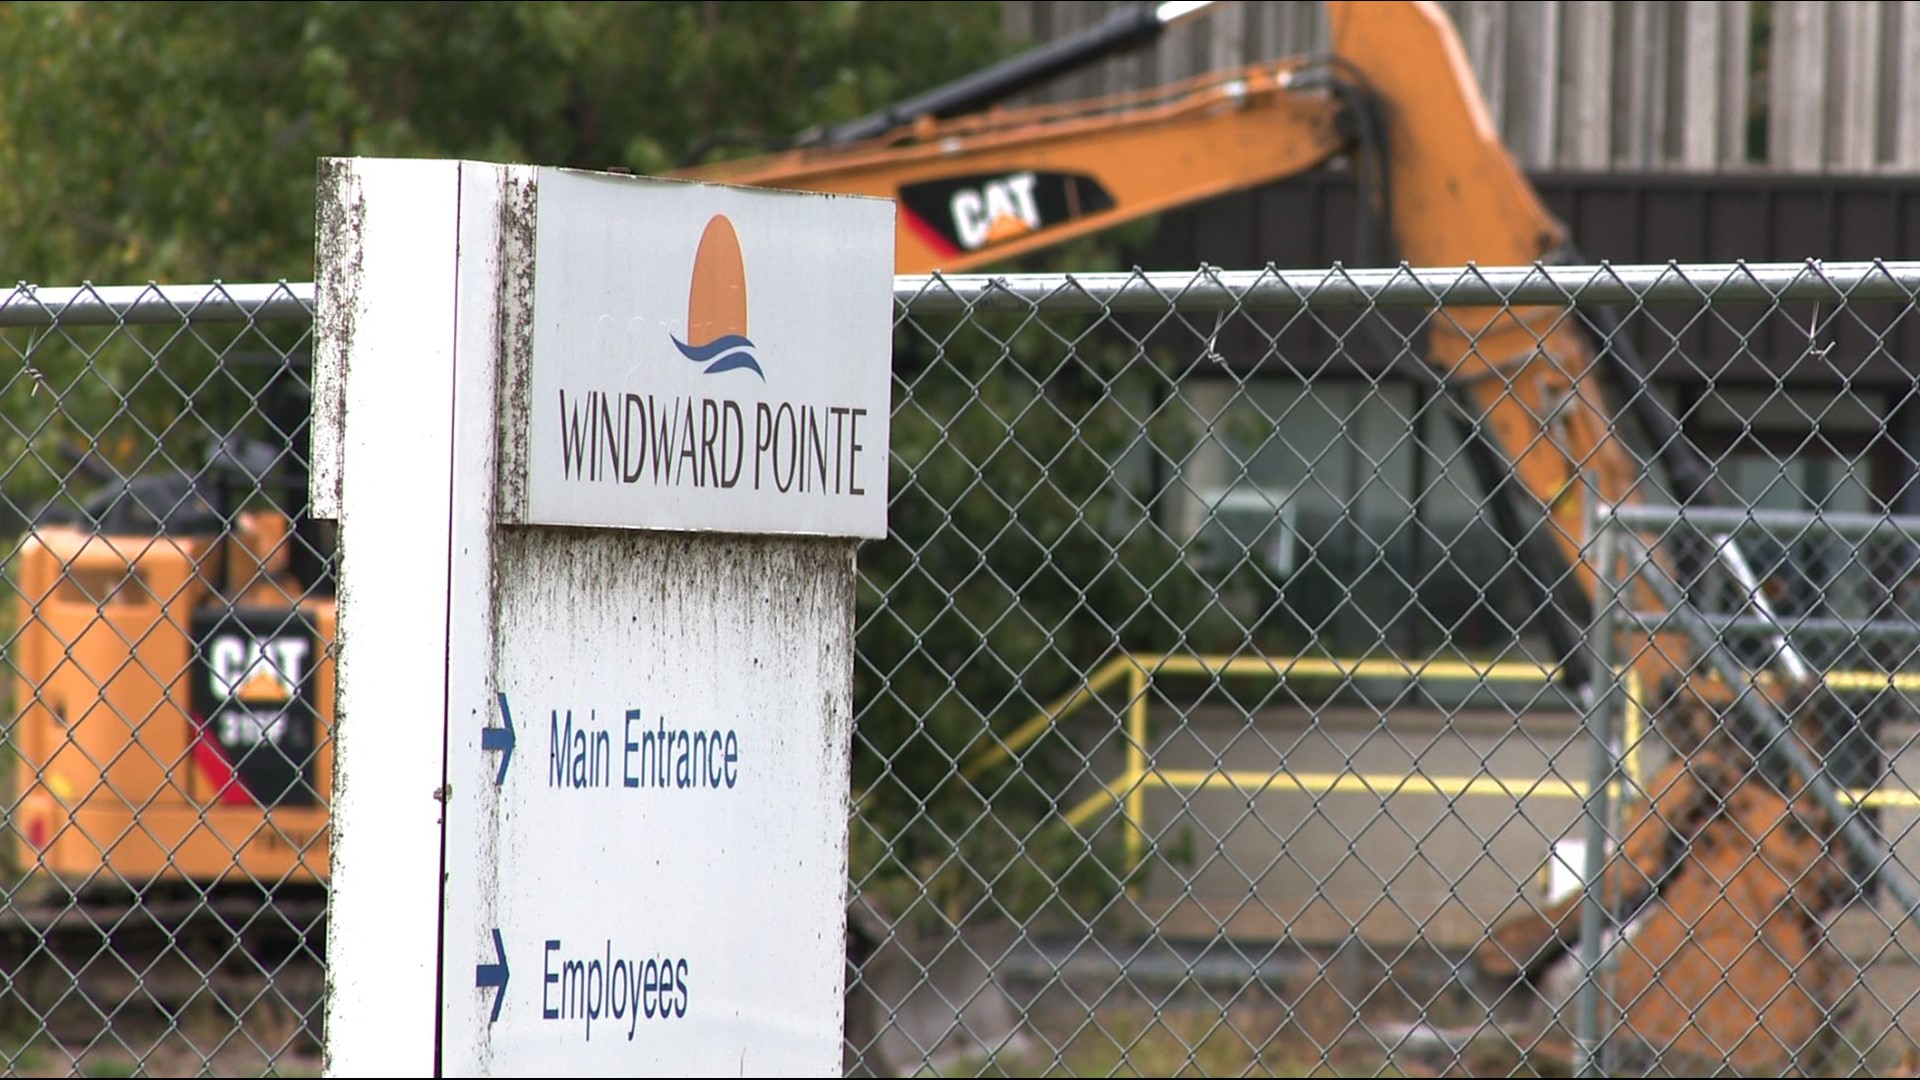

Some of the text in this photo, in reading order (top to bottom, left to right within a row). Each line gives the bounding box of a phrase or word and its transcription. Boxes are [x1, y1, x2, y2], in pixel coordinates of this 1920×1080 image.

[952, 170, 1041, 248] CAT
[559, 388, 867, 495] WINDWARD POINTE
[211, 636, 309, 700] CAT
[549, 709, 738, 789] Main Entrance
[543, 939, 688, 1041] Employees
